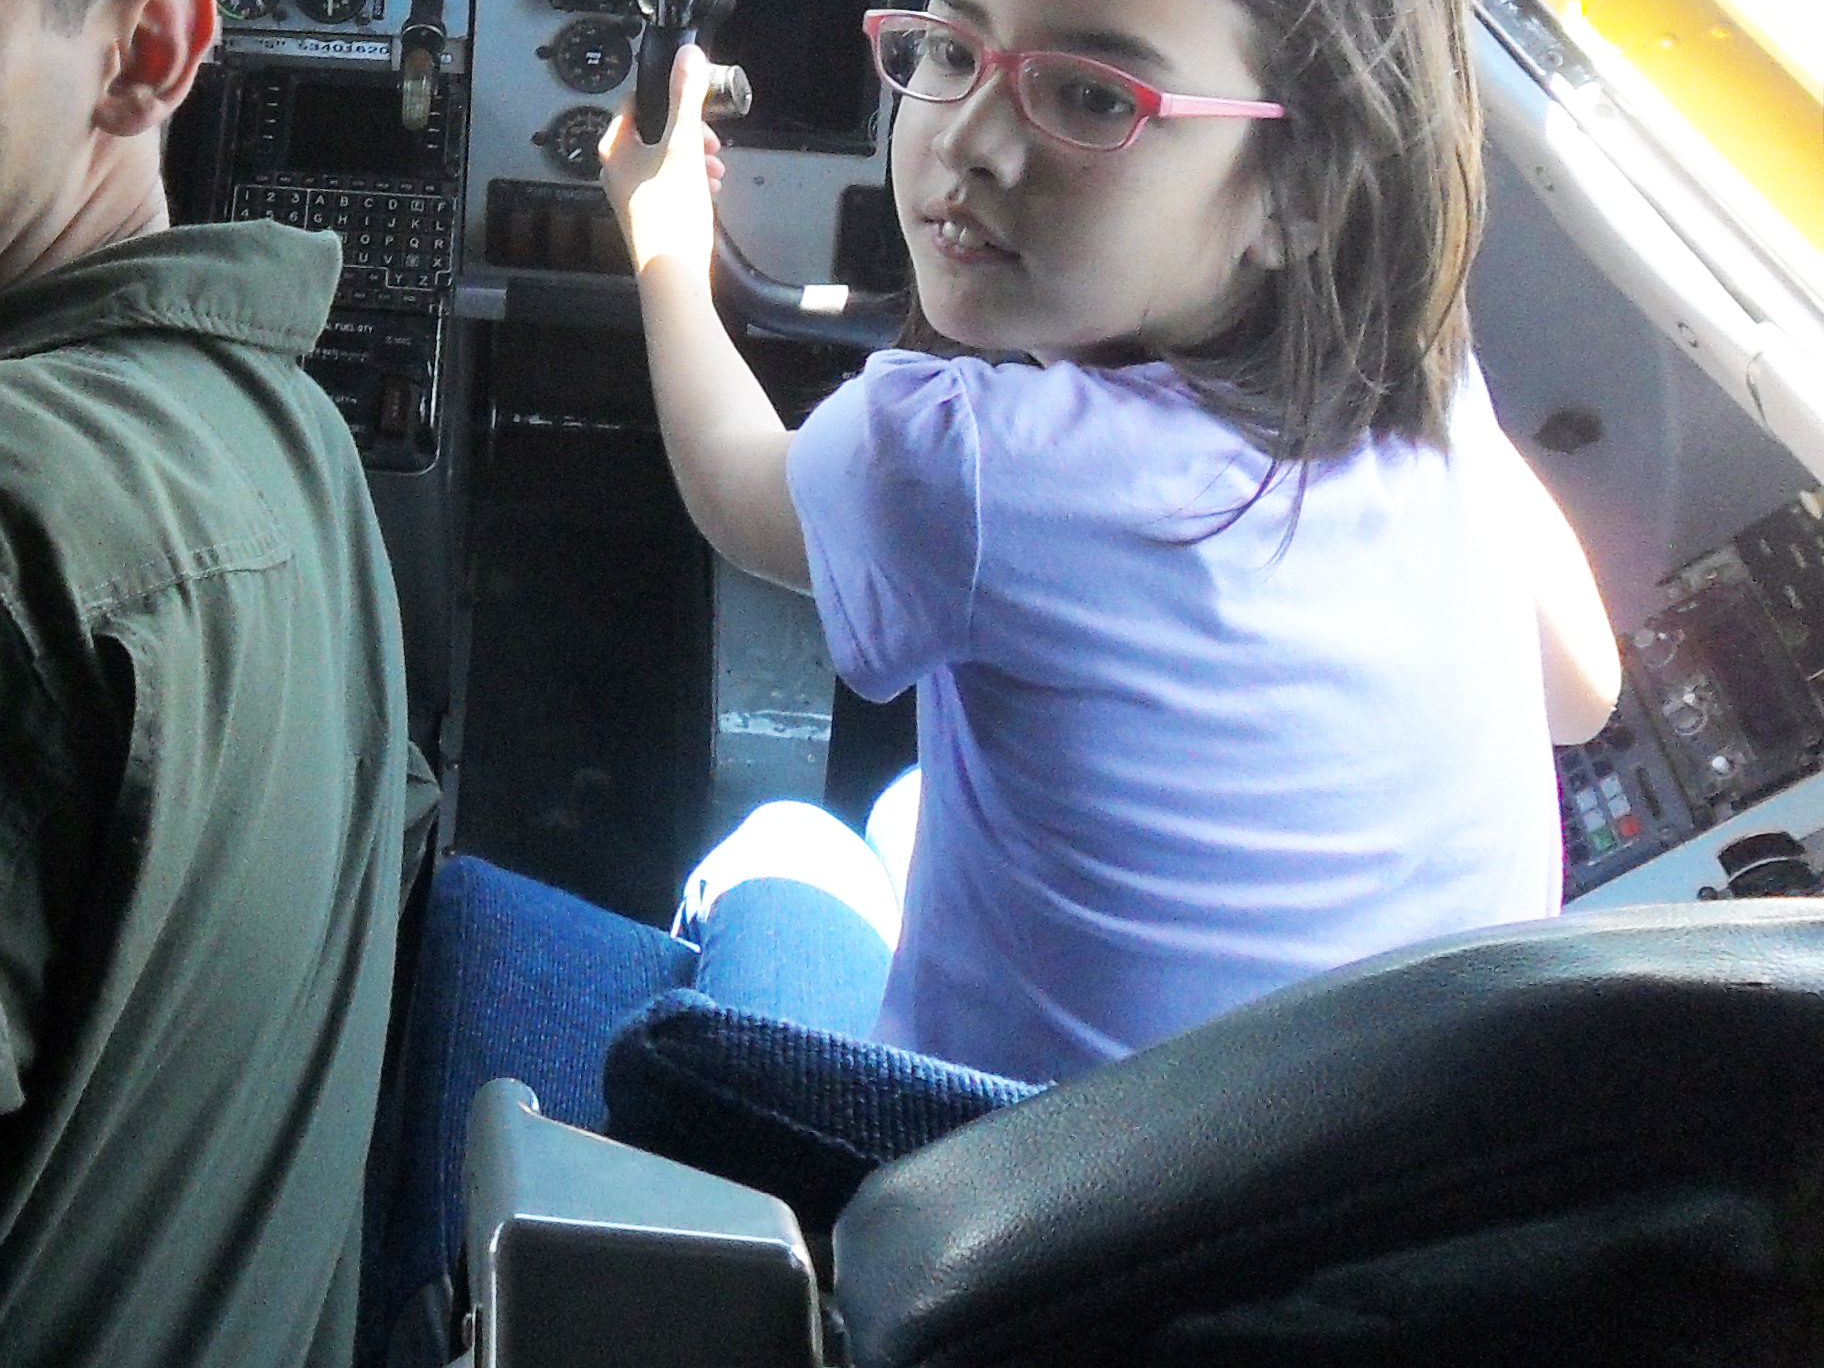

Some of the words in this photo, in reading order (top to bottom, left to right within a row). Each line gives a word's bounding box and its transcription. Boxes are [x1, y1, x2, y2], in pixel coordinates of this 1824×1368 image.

[266, 192, 276, 203] 2
[290, 193, 301, 204] 3
[315, 194, 325, 206] A
[339, 195, 349, 208] B
[363, 197, 374, 209] C
[388, 198, 398, 211] D
[437, 201, 447, 213] F
[289, 210, 299, 223] 6
[313, 212, 323, 225] G
[337, 214, 349, 226] H
[388, 217, 397, 229] J
[411, 218, 421, 230] K
[436, 220, 445, 232] L
[359, 233, 371, 245] O
[385, 234, 395, 247] P
[409, 236, 420, 249] Q
[434, 238, 445, 250] R
[358, 252, 369, 264] U
[383, 254, 393, 265] V
[432, 256, 443, 269] X
[395, 273, 404, 285] Y
[418, 275, 429, 287] Z
[334, 322, 356, 332] FUEL
